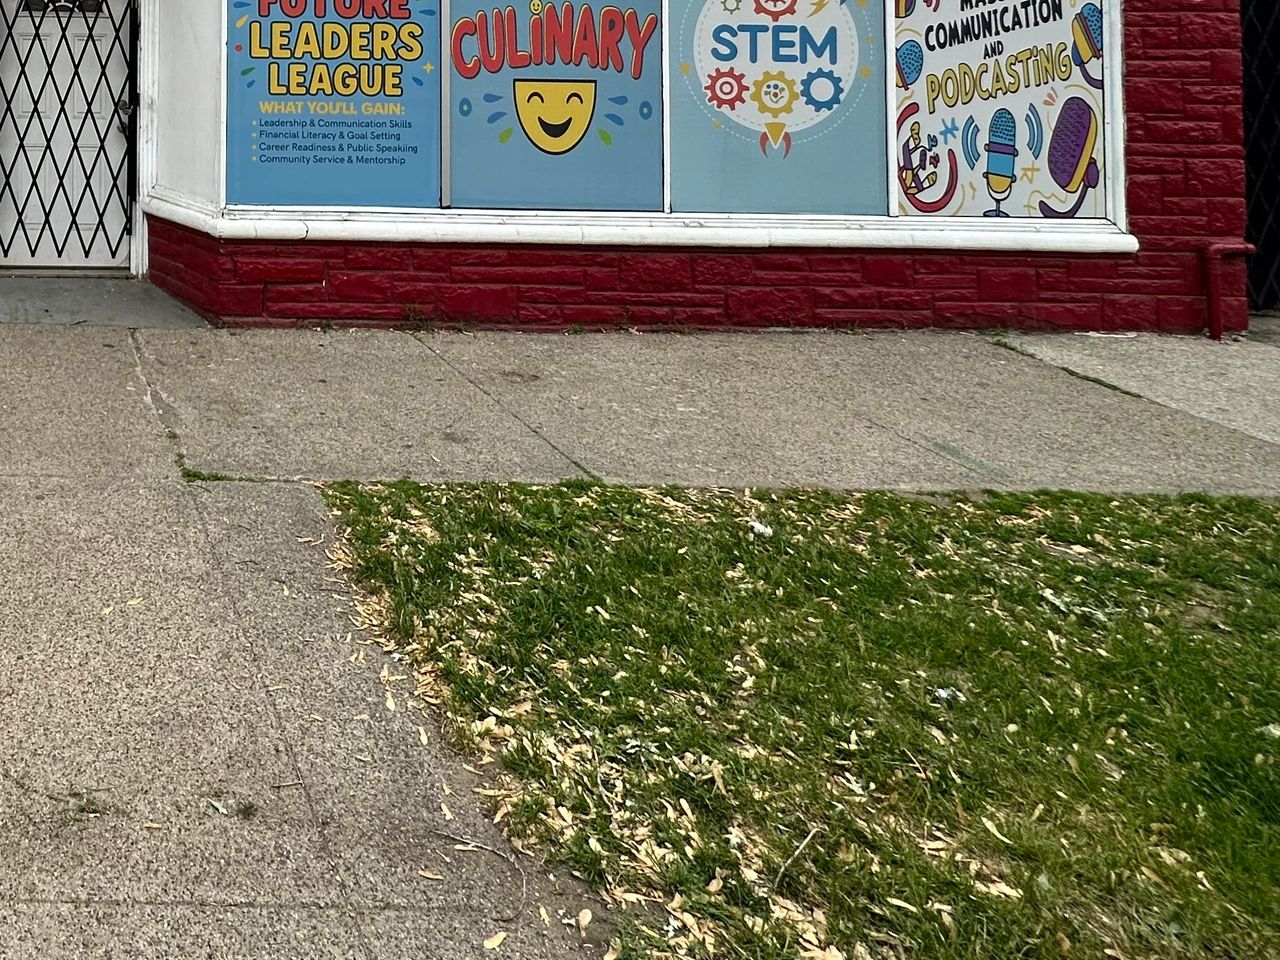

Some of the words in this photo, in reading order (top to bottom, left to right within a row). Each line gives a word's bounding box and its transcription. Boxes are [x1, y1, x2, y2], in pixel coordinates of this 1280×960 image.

[249, 21, 423, 60] LEADERS
[710, 24, 837, 65] STEM
[982, 40, 1004, 60] AND
[268, 62, 403, 96] LEAGUE
[259, 102, 303, 114] WHAT
[307, 102, 357, 115] YOU'LL
[361, 103, 405, 115] GAIN:
[259, 119, 307, 129] Leadership
[317, 120, 387, 129] Communication
[389, 120, 412, 129] Skills
[259, 131, 299, 139] Financial
[301, 131, 336, 141] Literacy
[347, 131, 368, 139] Goal
[370, 132, 401, 141] Setting
[259, 143, 289, 151] Career
[292, 143, 336, 151] Readiness
[347, 144, 373, 152] Public
[259, 155, 310, 164] Community
[313, 155, 345, 164] Service
[347, 156, 353, 164] &
[355, 156, 406, 165] Mentorship
